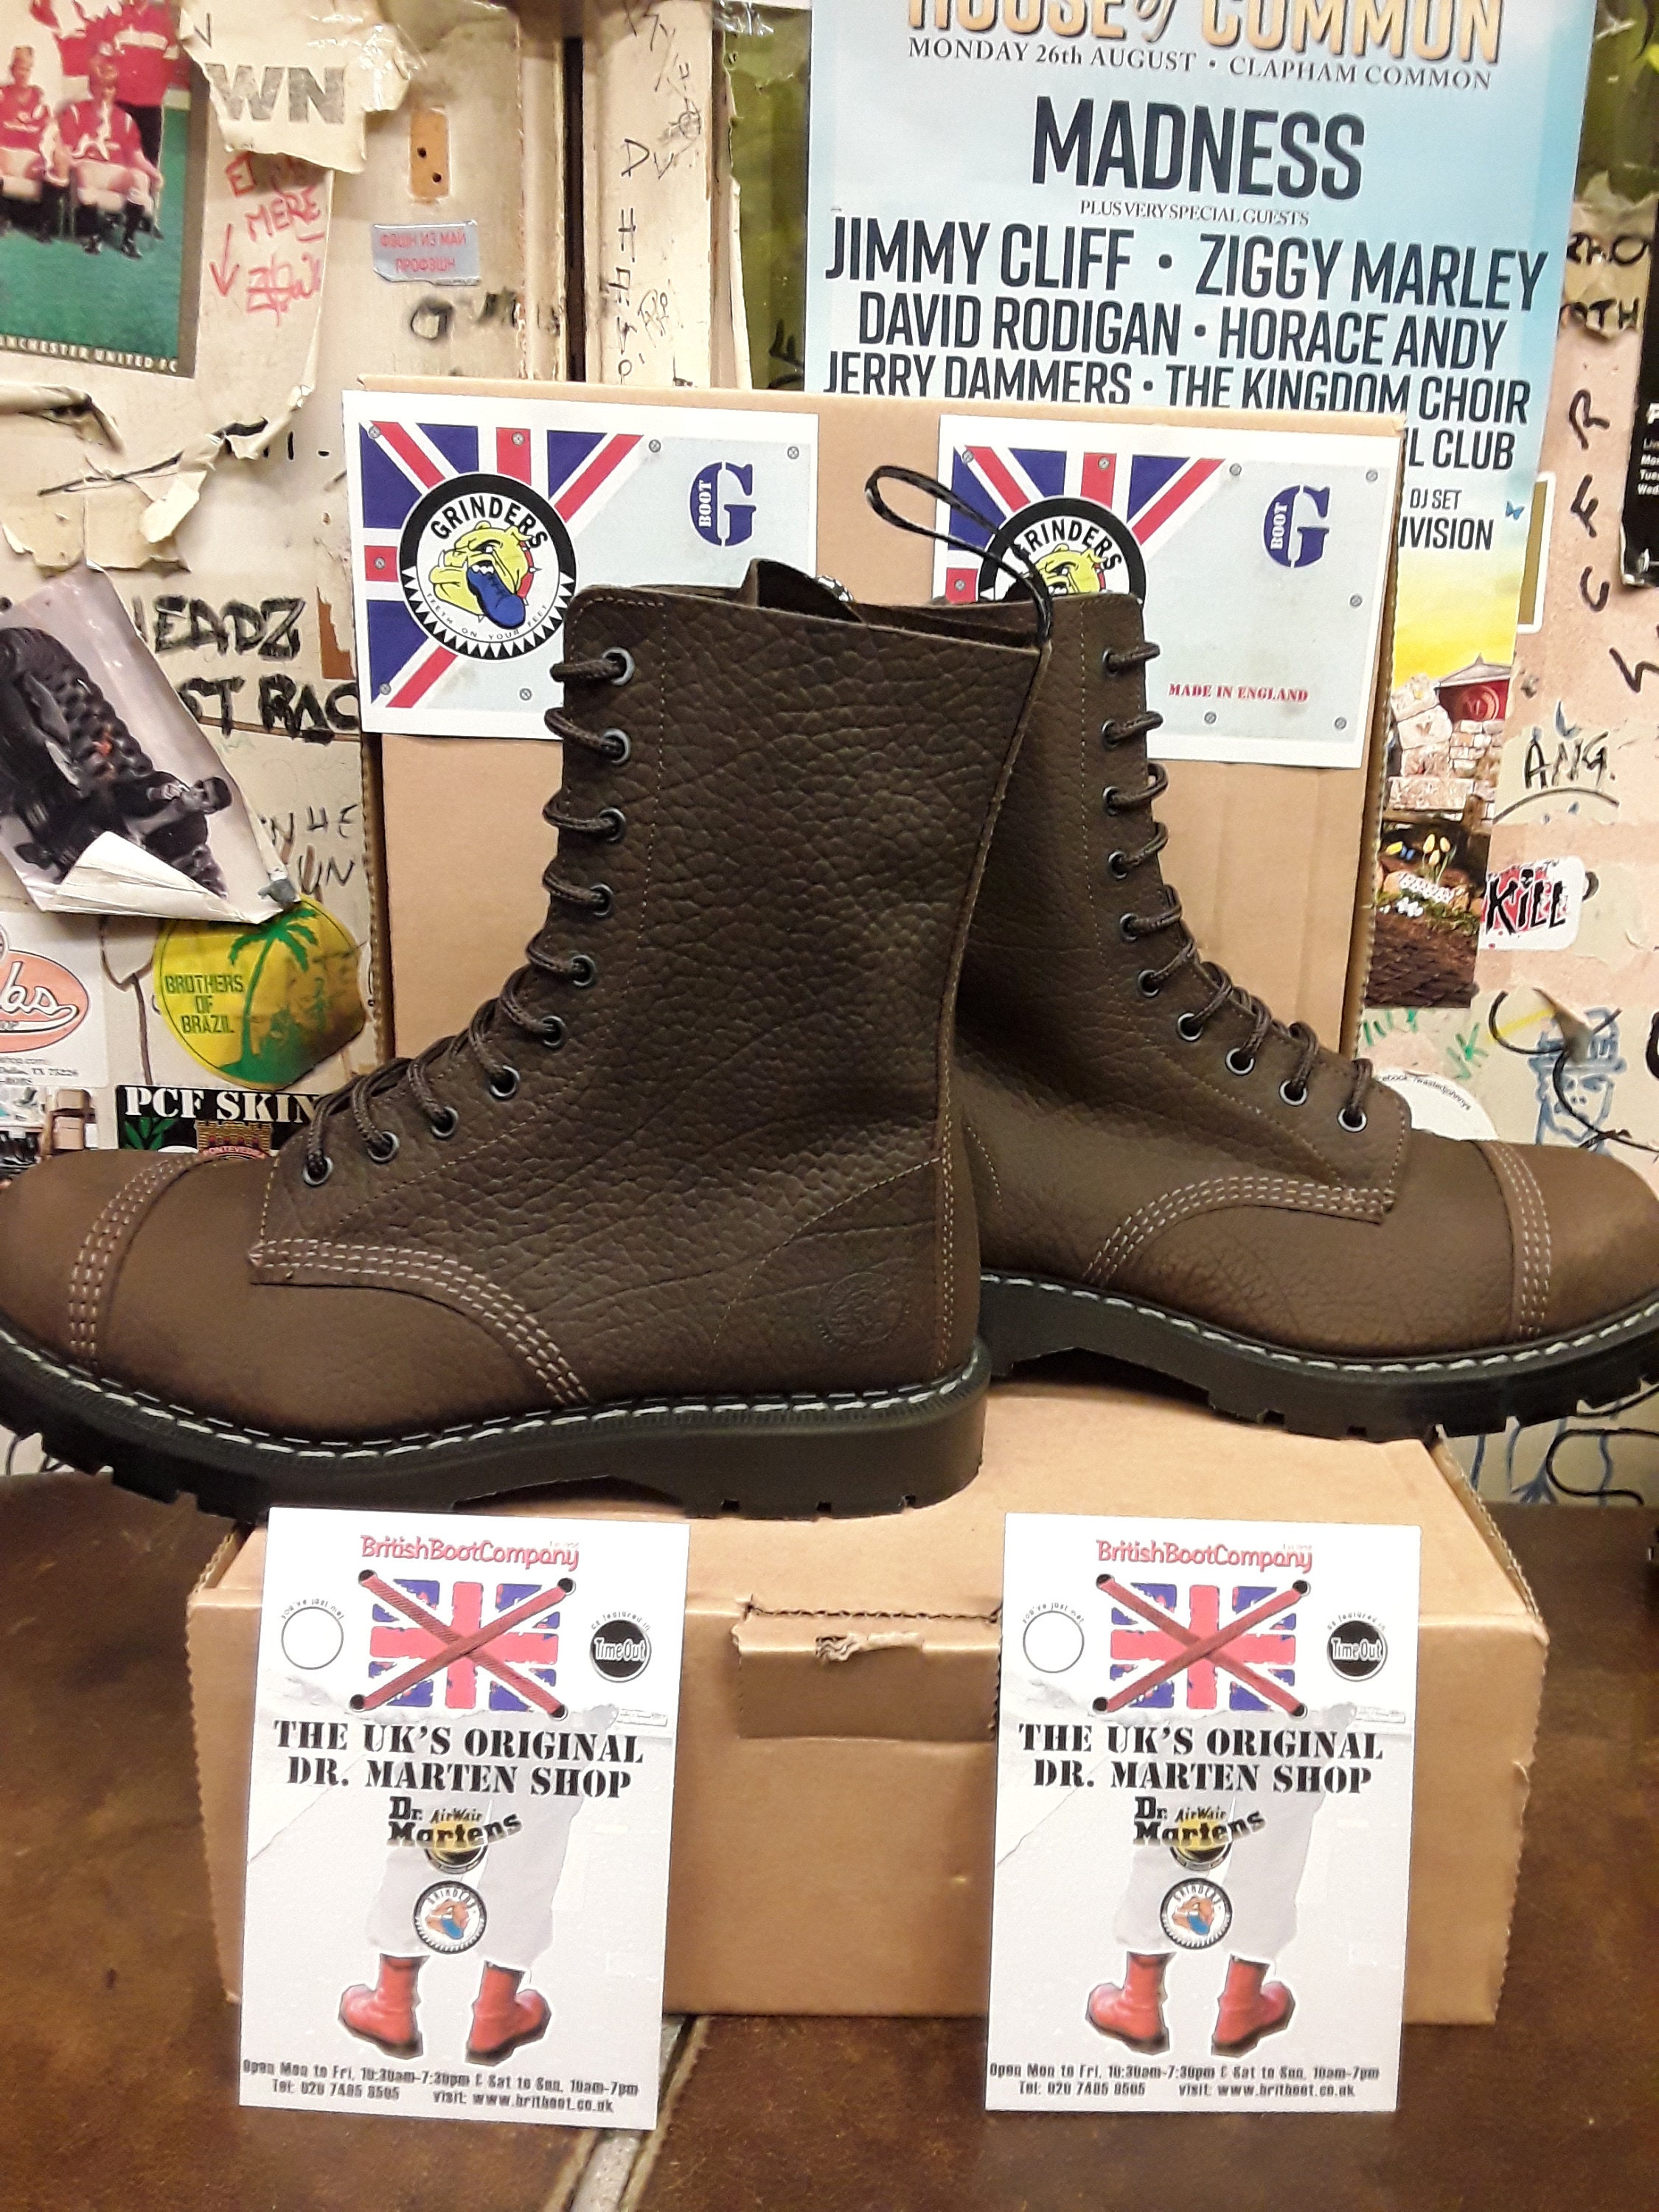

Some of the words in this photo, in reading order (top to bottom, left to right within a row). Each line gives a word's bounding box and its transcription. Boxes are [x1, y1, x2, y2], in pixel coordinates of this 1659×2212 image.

[1202, 0, 1503, 63] COMMON
[909, 37, 1029, 61] MONDAY
[1036, 44, 1082, 65] 26th
[1091, 46, 1197, 72] AUGUST
[1229, 55, 1357, 83] CLAPHAM
[1365, 66, 1491, 90] COMMON
[1032, 96, 1365, 201] MADNESS
[1080, 200, 1122, 216] PLUS
[1124, 202, 1167, 218] VERY
[1169, 204, 1240, 222] SPECIAL
[1242, 207, 1310, 226] GUESTS
[825, 215, 990, 285] JIMMY
[1001, 223, 1135, 291] CLIFF
[1195, 232, 1343, 302] ZIGGY
[1351, 240, 1549, 311] MARLEY
[859, 291, 981, 349] DAVID
[992, 296, 1181, 356] RODIGAN
[1218, 306, 1388, 366] HORACE
[1391, 314, 1507, 370] ANDY
[823, 351, 936, 398] JERRY
[944, 355, 1132, 406] DAMMERS
[1166, 364, 1234, 409] THE
[1242, 367, 1412, 416] KINGDOM
[1419, 375, 1531, 425] CHOIR
[1432, 428, 1516, 470] CLUB
[689, 462, 757, 547] G
[698, 479, 712, 528] BOOT
[1410, 487, 1428, 509] DJ
[1431, 488, 1463, 510] SET
[430, 495, 549, 549] GRINDERS
[1263, 484, 1331, 568] G
[1270, 501, 1288, 549] BOOT
[1015, 518, 1122, 571] RINDERS
[461, 627, 478, 639] ON
[527, 604, 547, 627] FEET
[1169, 683, 1212, 698] MADE
[1217, 685, 1234, 699] IN
[1237, 686, 1310, 703] ENGLAND
[164, 974, 244, 994] BROTHERS
[195, 995, 213, 1014] OF
[181, 1014, 234, 1034] BRAZIL
[124, 1086, 206, 1119] PCF
[274, 1719, 349, 1750] THE
[363, 1723, 452, 1755] UK'S
[465, 1728, 644, 1764] ORIGINAL
[1018, 1722, 1093, 1752] THE
[1107, 1725, 1194, 1755] UK'S
[1206, 1728, 1383, 1760] ORIGINAL
[287, 1756, 349, 1787] DR.
[364, 1759, 518, 1793] MARTEN
[530, 1766, 631, 1798] SHOP
[1033, 1759, 1095, 1787] DR.
[1110, 1760, 1261, 1792] MARTEN
[1273, 1764, 1372, 1794] SHOP
[389, 1795, 423, 1820] Dr.
[1133, 1795, 1168, 1820] Dr.
[386, 1813, 524, 1847] Martens
[1133, 1810, 1267, 1846] Martens
[243, 2059, 275, 2076] Open
[279, 2061, 308, 2077] Mon
[314, 2063, 328, 2078] to
[990, 2062, 1022, 2078] Open
[1026, 2063, 1055, 2078] Mon
[1061, 2064, 1075, 2078] to
